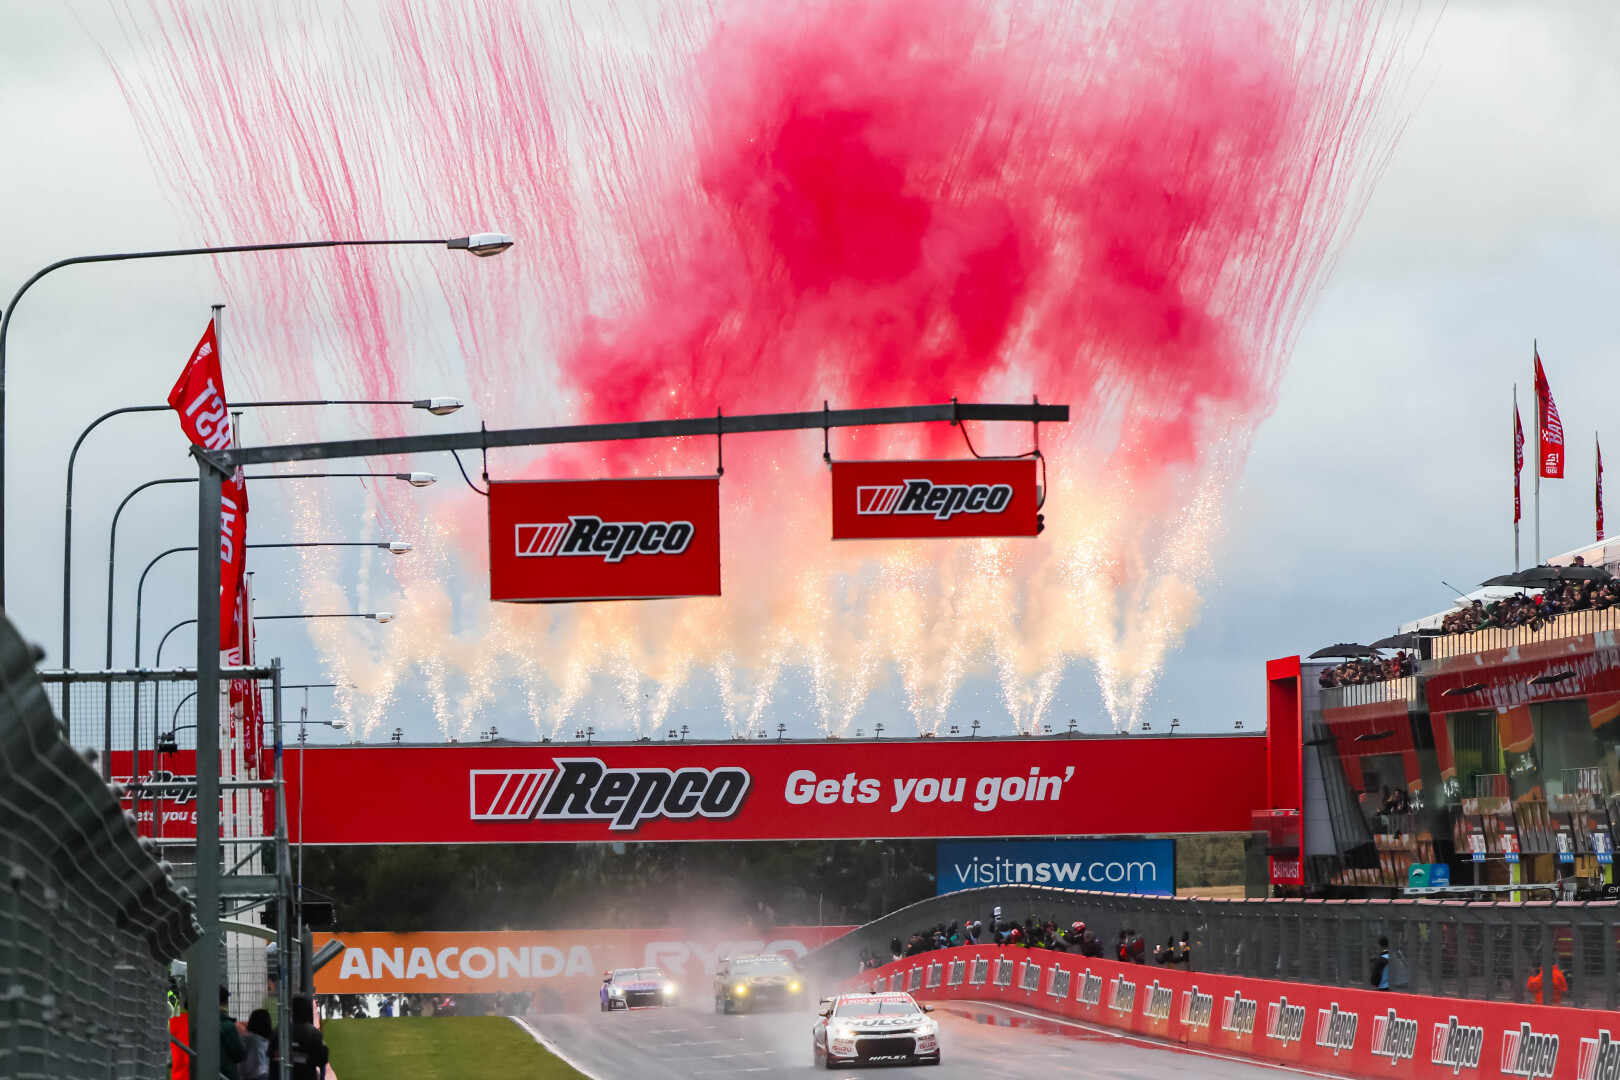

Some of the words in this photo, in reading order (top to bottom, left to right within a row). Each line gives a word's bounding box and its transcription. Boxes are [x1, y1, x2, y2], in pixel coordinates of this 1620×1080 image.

[893, 479, 1013, 520] Repco
[556, 515, 695, 562] Repco
[535, 757, 750, 830] Repco
[785, 769, 881, 804] Gets
[890, 777, 966, 813] you
[161, 811, 189, 825] you
[955, 856, 1156, 883] visitnsw.com
[339, 945, 597, 980] ANACONDA
[1230, 990, 1257, 1039] Repco
[1275, 995, 1305, 1047] Repco
[1326, 1002, 1358, 1056] Repco
[1381, 1008, 1418, 1065] Repco
[1443, 1015, 1484, 1075] Repco
[1514, 1022, 1559, 1080] Repco
